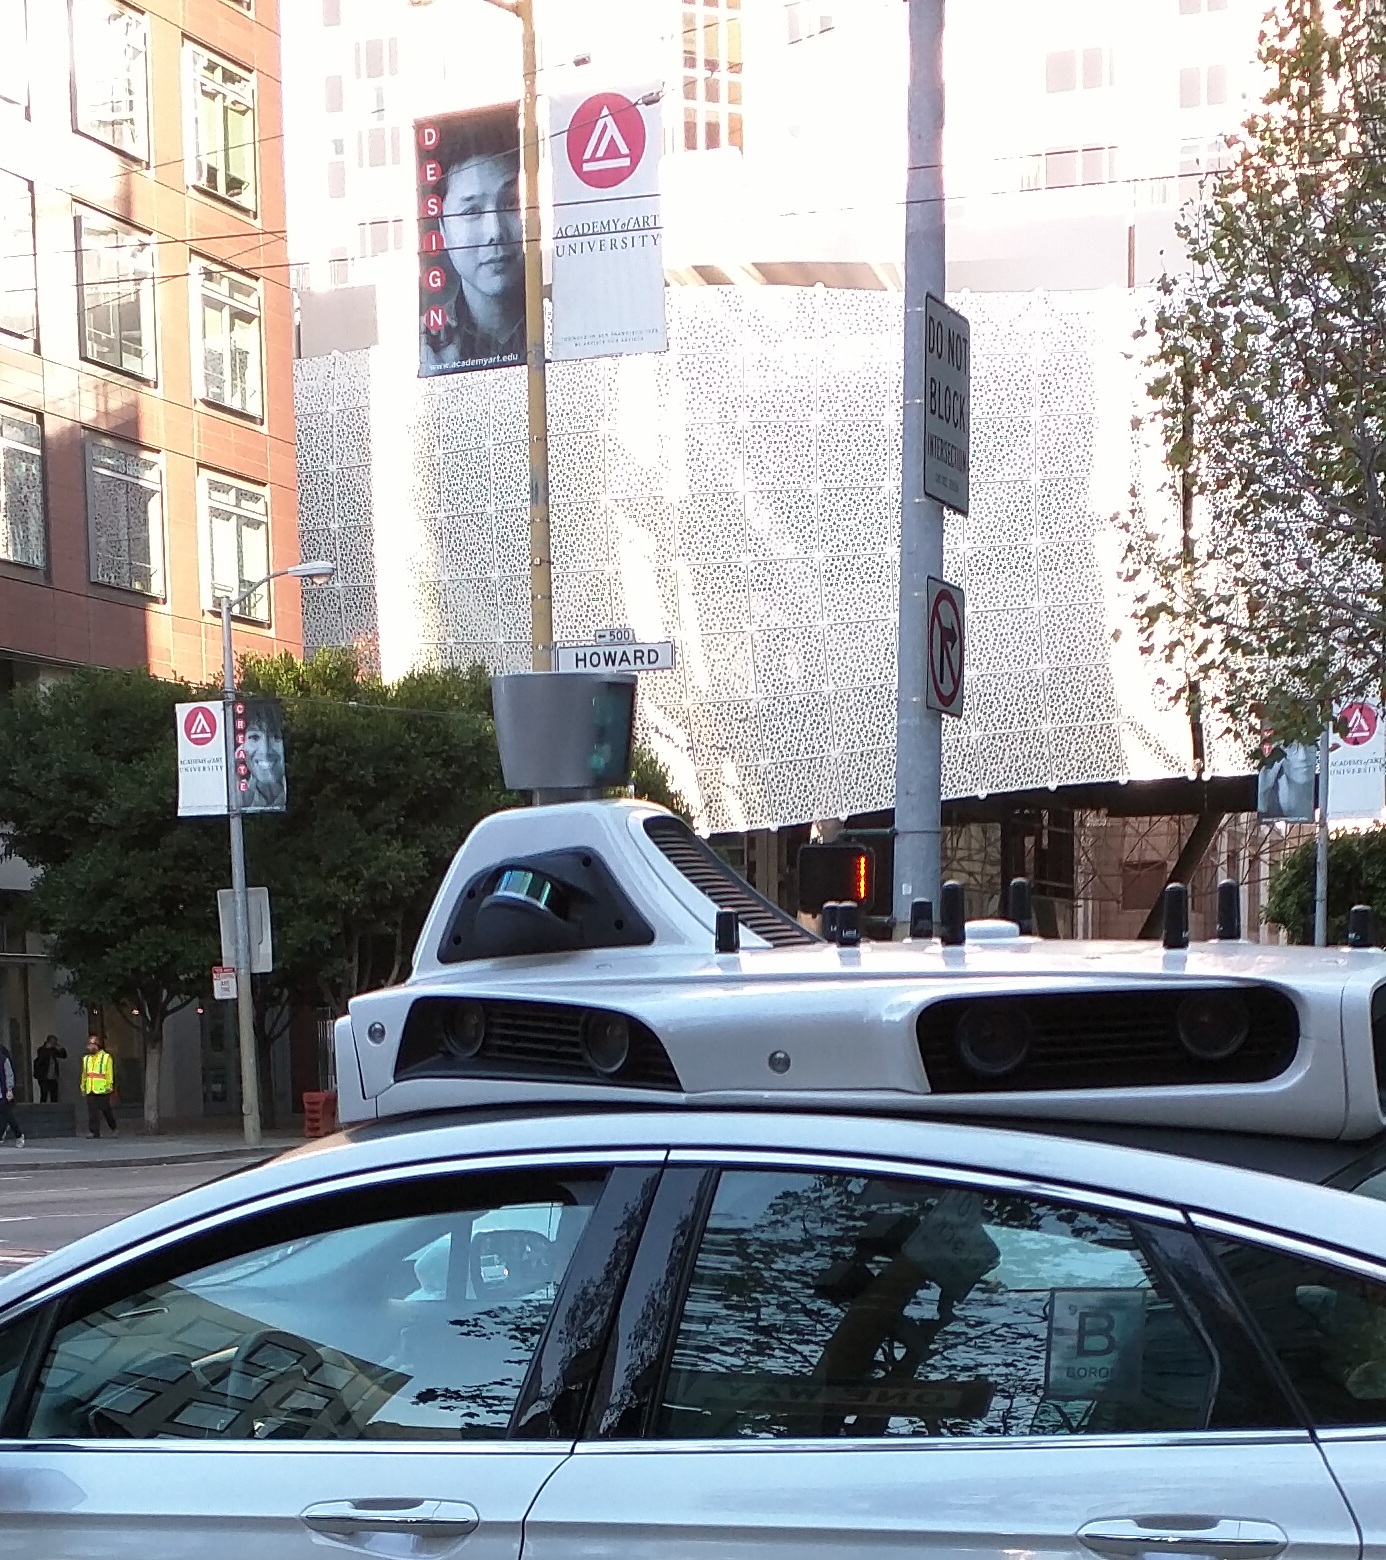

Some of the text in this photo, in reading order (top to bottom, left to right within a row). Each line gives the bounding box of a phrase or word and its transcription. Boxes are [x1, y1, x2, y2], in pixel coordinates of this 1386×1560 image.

[424, 128, 443, 326] DESIGN
[556, 218, 620, 238] ACADEMY
[633, 214, 659, 229] ART
[555, 233, 660, 258] UNIVERSITY
[429, 352, 518, 371] www.academyart.edu
[929, 315, 968, 376] DO NOT
[930, 376, 966, 433] BLOCK
[927, 431, 966, 473] INTERSECTION
[609, 629, 630, 641] 500
[575, 648, 660, 669] HOWARD
[1076, 1311, 1116, 1357] B
